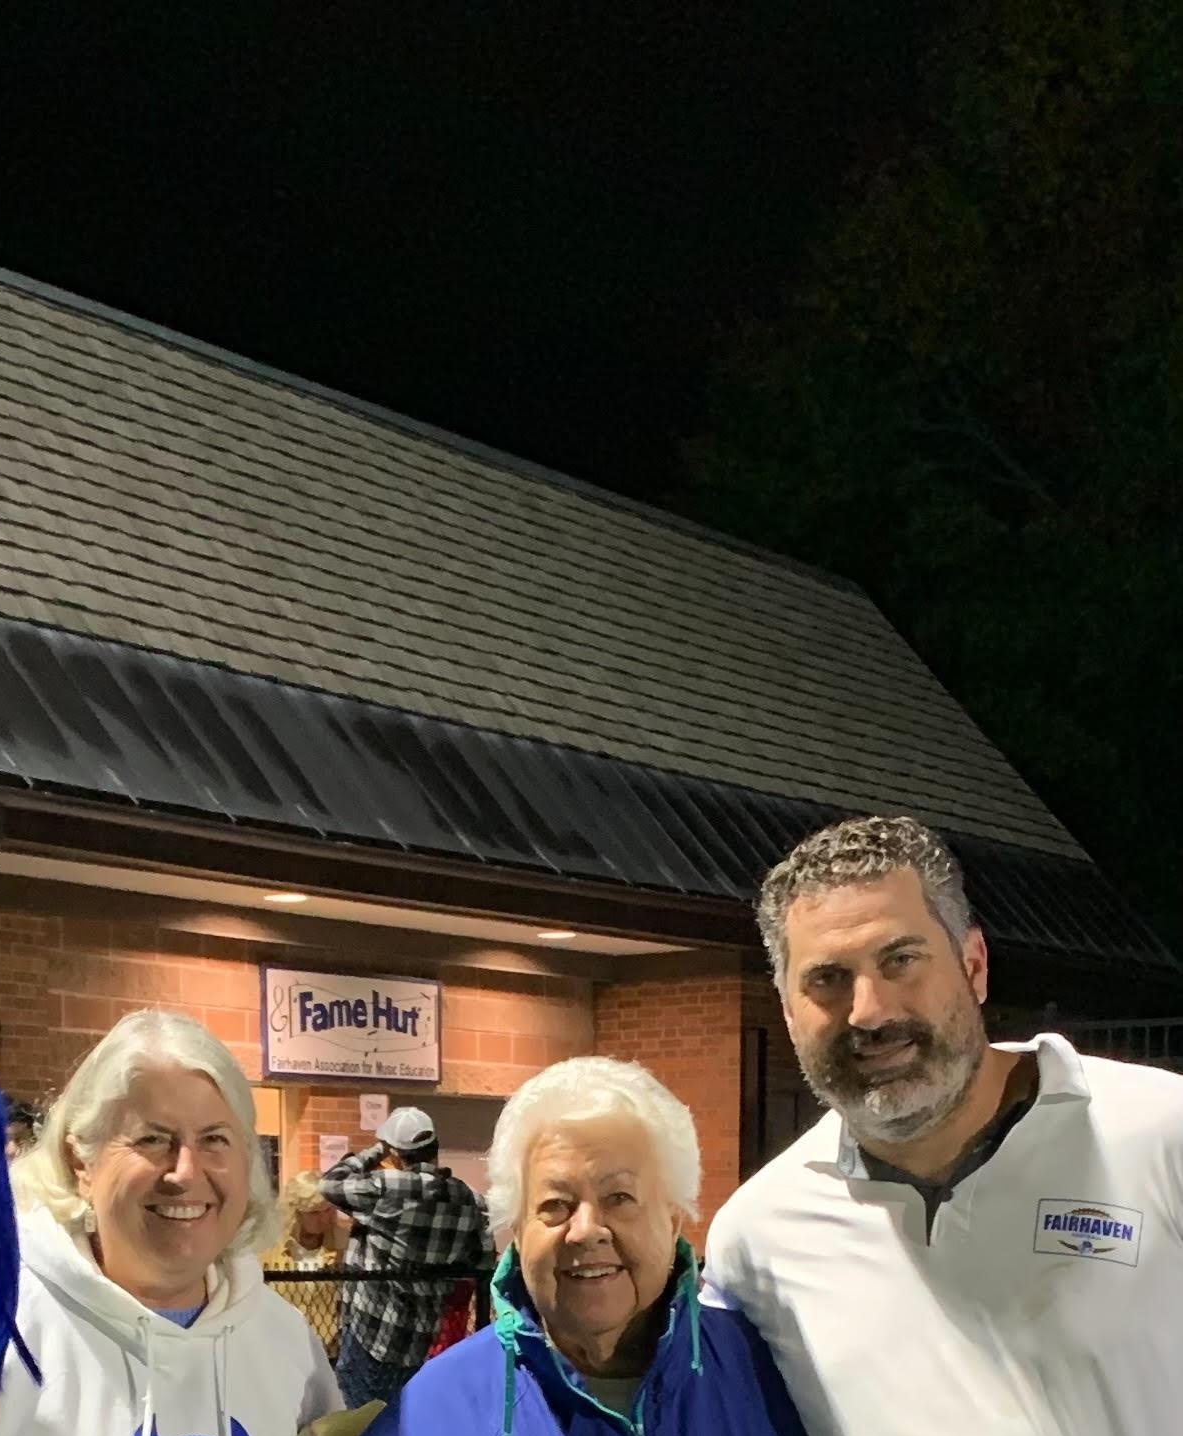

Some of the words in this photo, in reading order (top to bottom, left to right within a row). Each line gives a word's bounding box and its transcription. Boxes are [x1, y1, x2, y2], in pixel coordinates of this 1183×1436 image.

[299, 991, 368, 1033] Fame
[372, 990, 420, 1037] Hut
[271, 1055, 312, 1071] Fairhaven
[315, 1058, 360, 1074] Association
[361, 1061, 373, 1074] for
[375, 1061, 397, 1076] Music
[399, 1064, 435, 1078] Education
[1043, 1213, 1134, 1242] FAIRHAVEN
